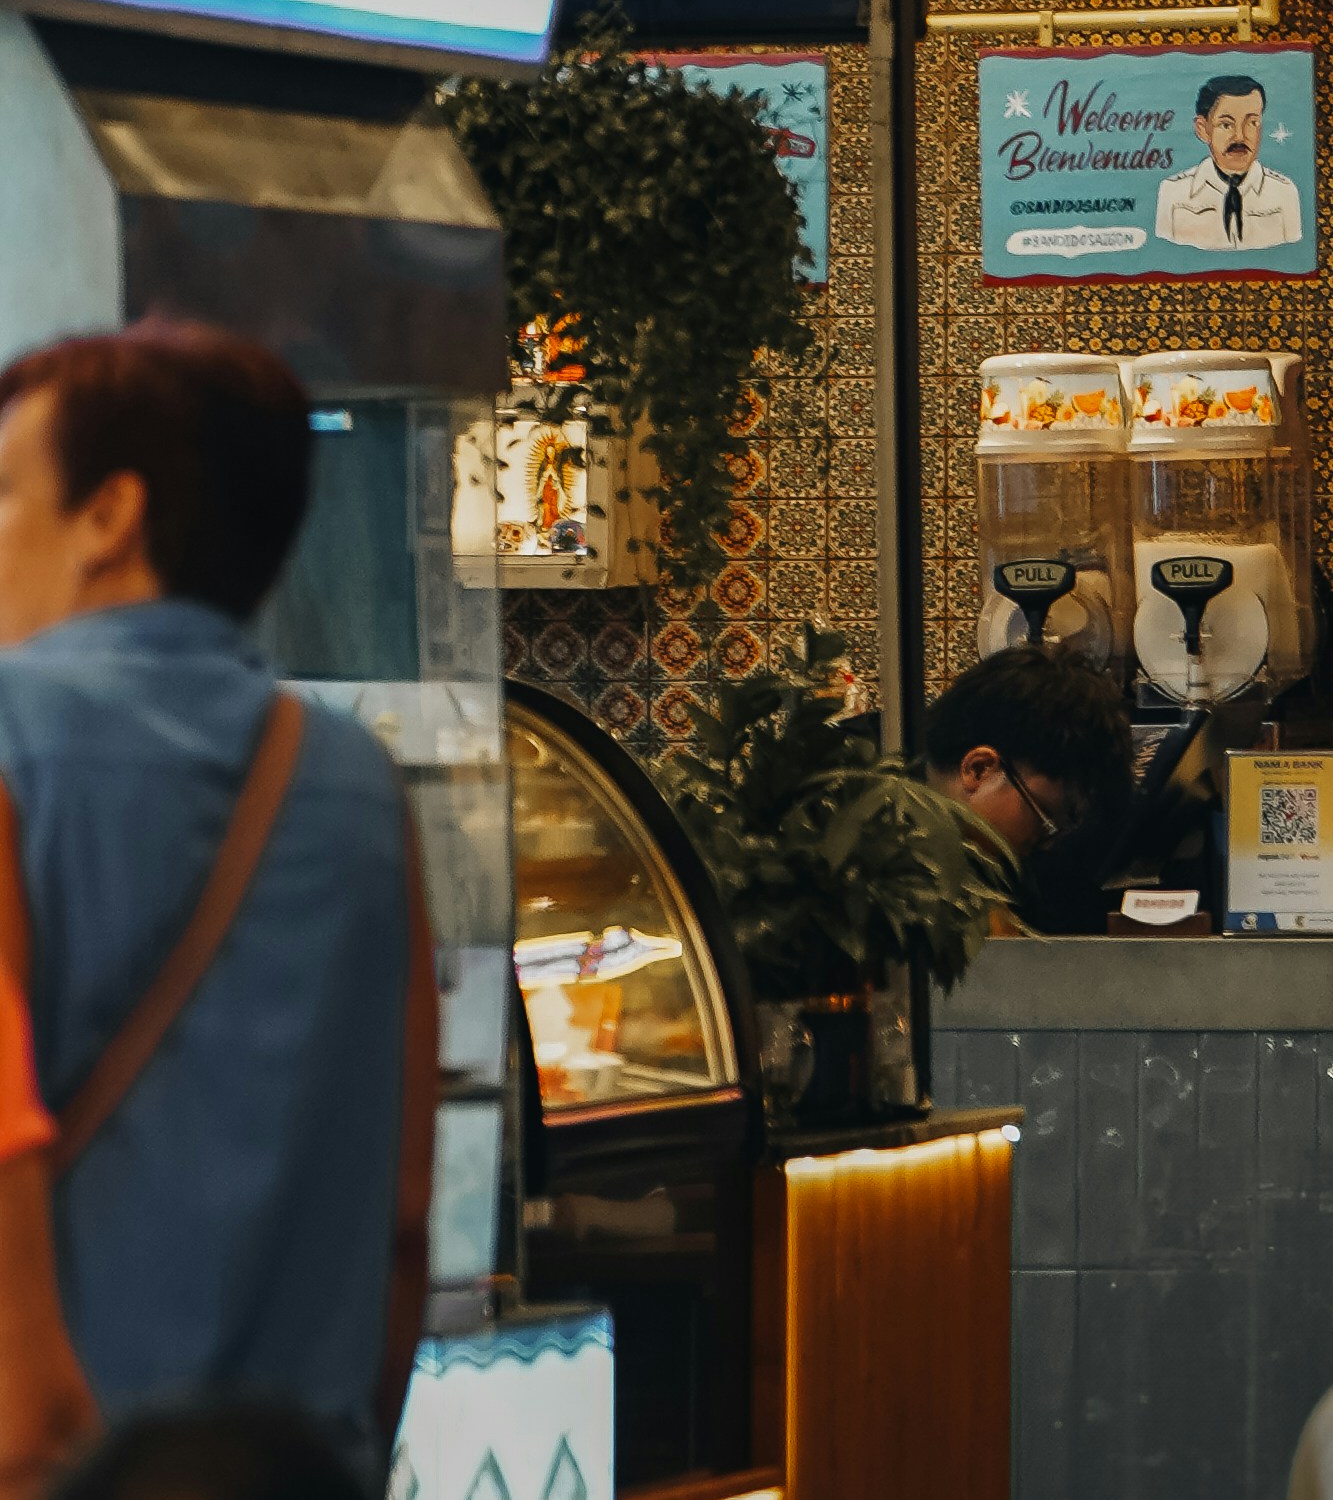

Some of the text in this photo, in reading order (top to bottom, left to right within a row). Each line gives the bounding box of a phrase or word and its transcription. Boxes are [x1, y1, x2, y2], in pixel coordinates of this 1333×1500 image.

[1044, 80, 1175, 137] Welcome
[1000, 131, 1174, 181] Bienvenidos
[1014, 567, 1057, 583] PULL
[1171, 563, 1213, 579] PULL
